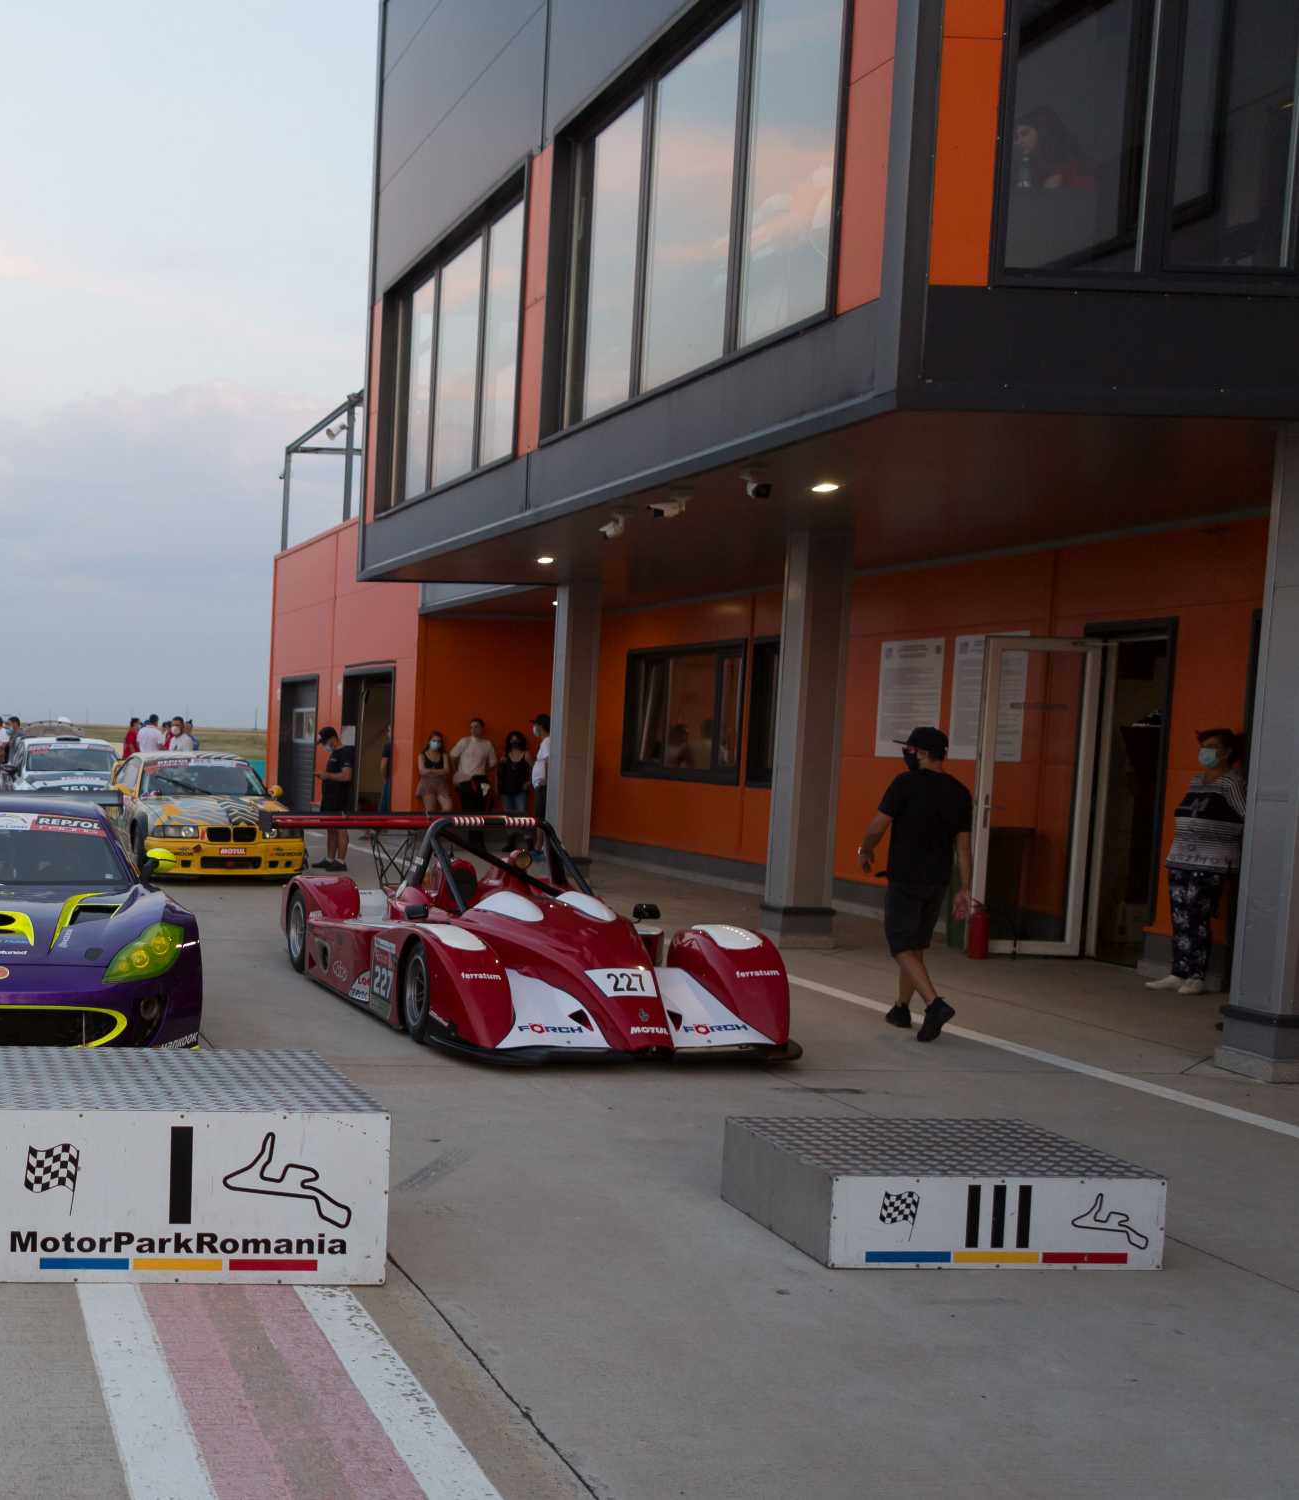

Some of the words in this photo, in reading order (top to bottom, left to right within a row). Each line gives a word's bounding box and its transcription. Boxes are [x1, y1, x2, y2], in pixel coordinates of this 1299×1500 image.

[38, 817, 101, 830] REPSOL
[461, 972, 502, 981] ferratum
[735, 969, 781, 978] ferratum
[373, 966, 393, 1001] 227
[606, 972, 646, 992] 227
[630, 1026, 669, 1035] MOTUL
[683, 1023, 749, 1034] FÖRCH
[9, 1230, 348, 1256] MotorParkRomania
